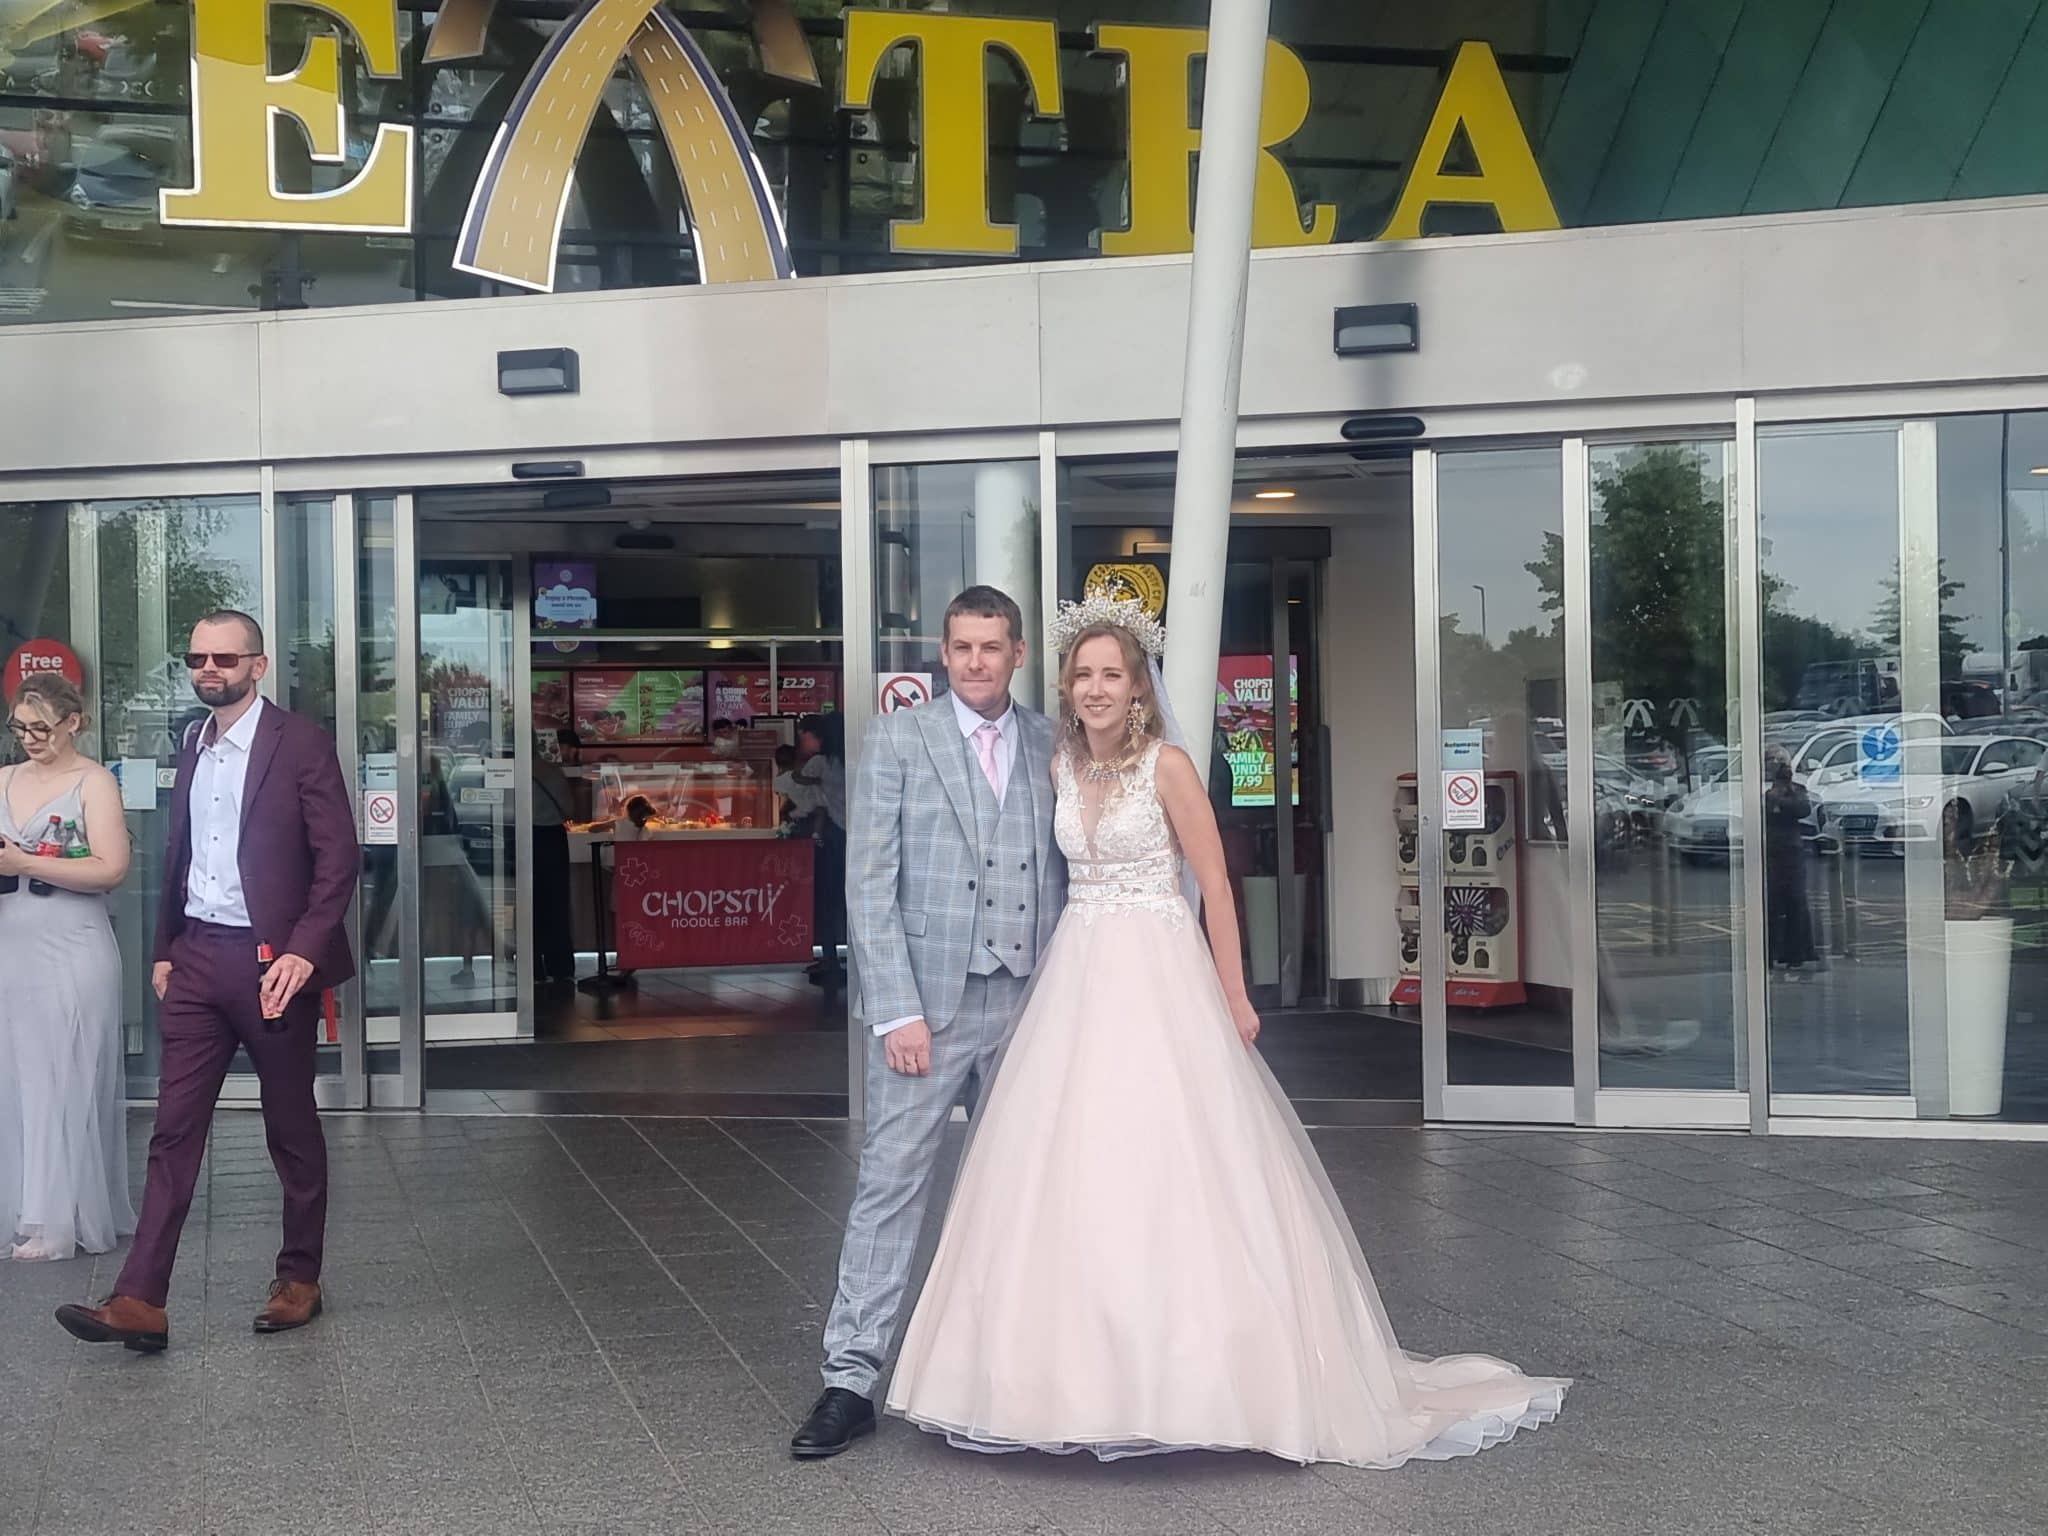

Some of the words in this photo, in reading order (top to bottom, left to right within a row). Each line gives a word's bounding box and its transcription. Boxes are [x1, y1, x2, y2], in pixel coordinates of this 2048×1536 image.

[19, 653, 63, 669] Free
[1233, 678, 1273, 689] CHOPST
[1234, 688, 1272, 702] VALU
[1231, 763, 1274, 775] UNDLE
[641, 883, 785, 926] CHOPSTIX
[671, 917, 720, 929] NOODLE
[724, 916, 749, 927] BAR
